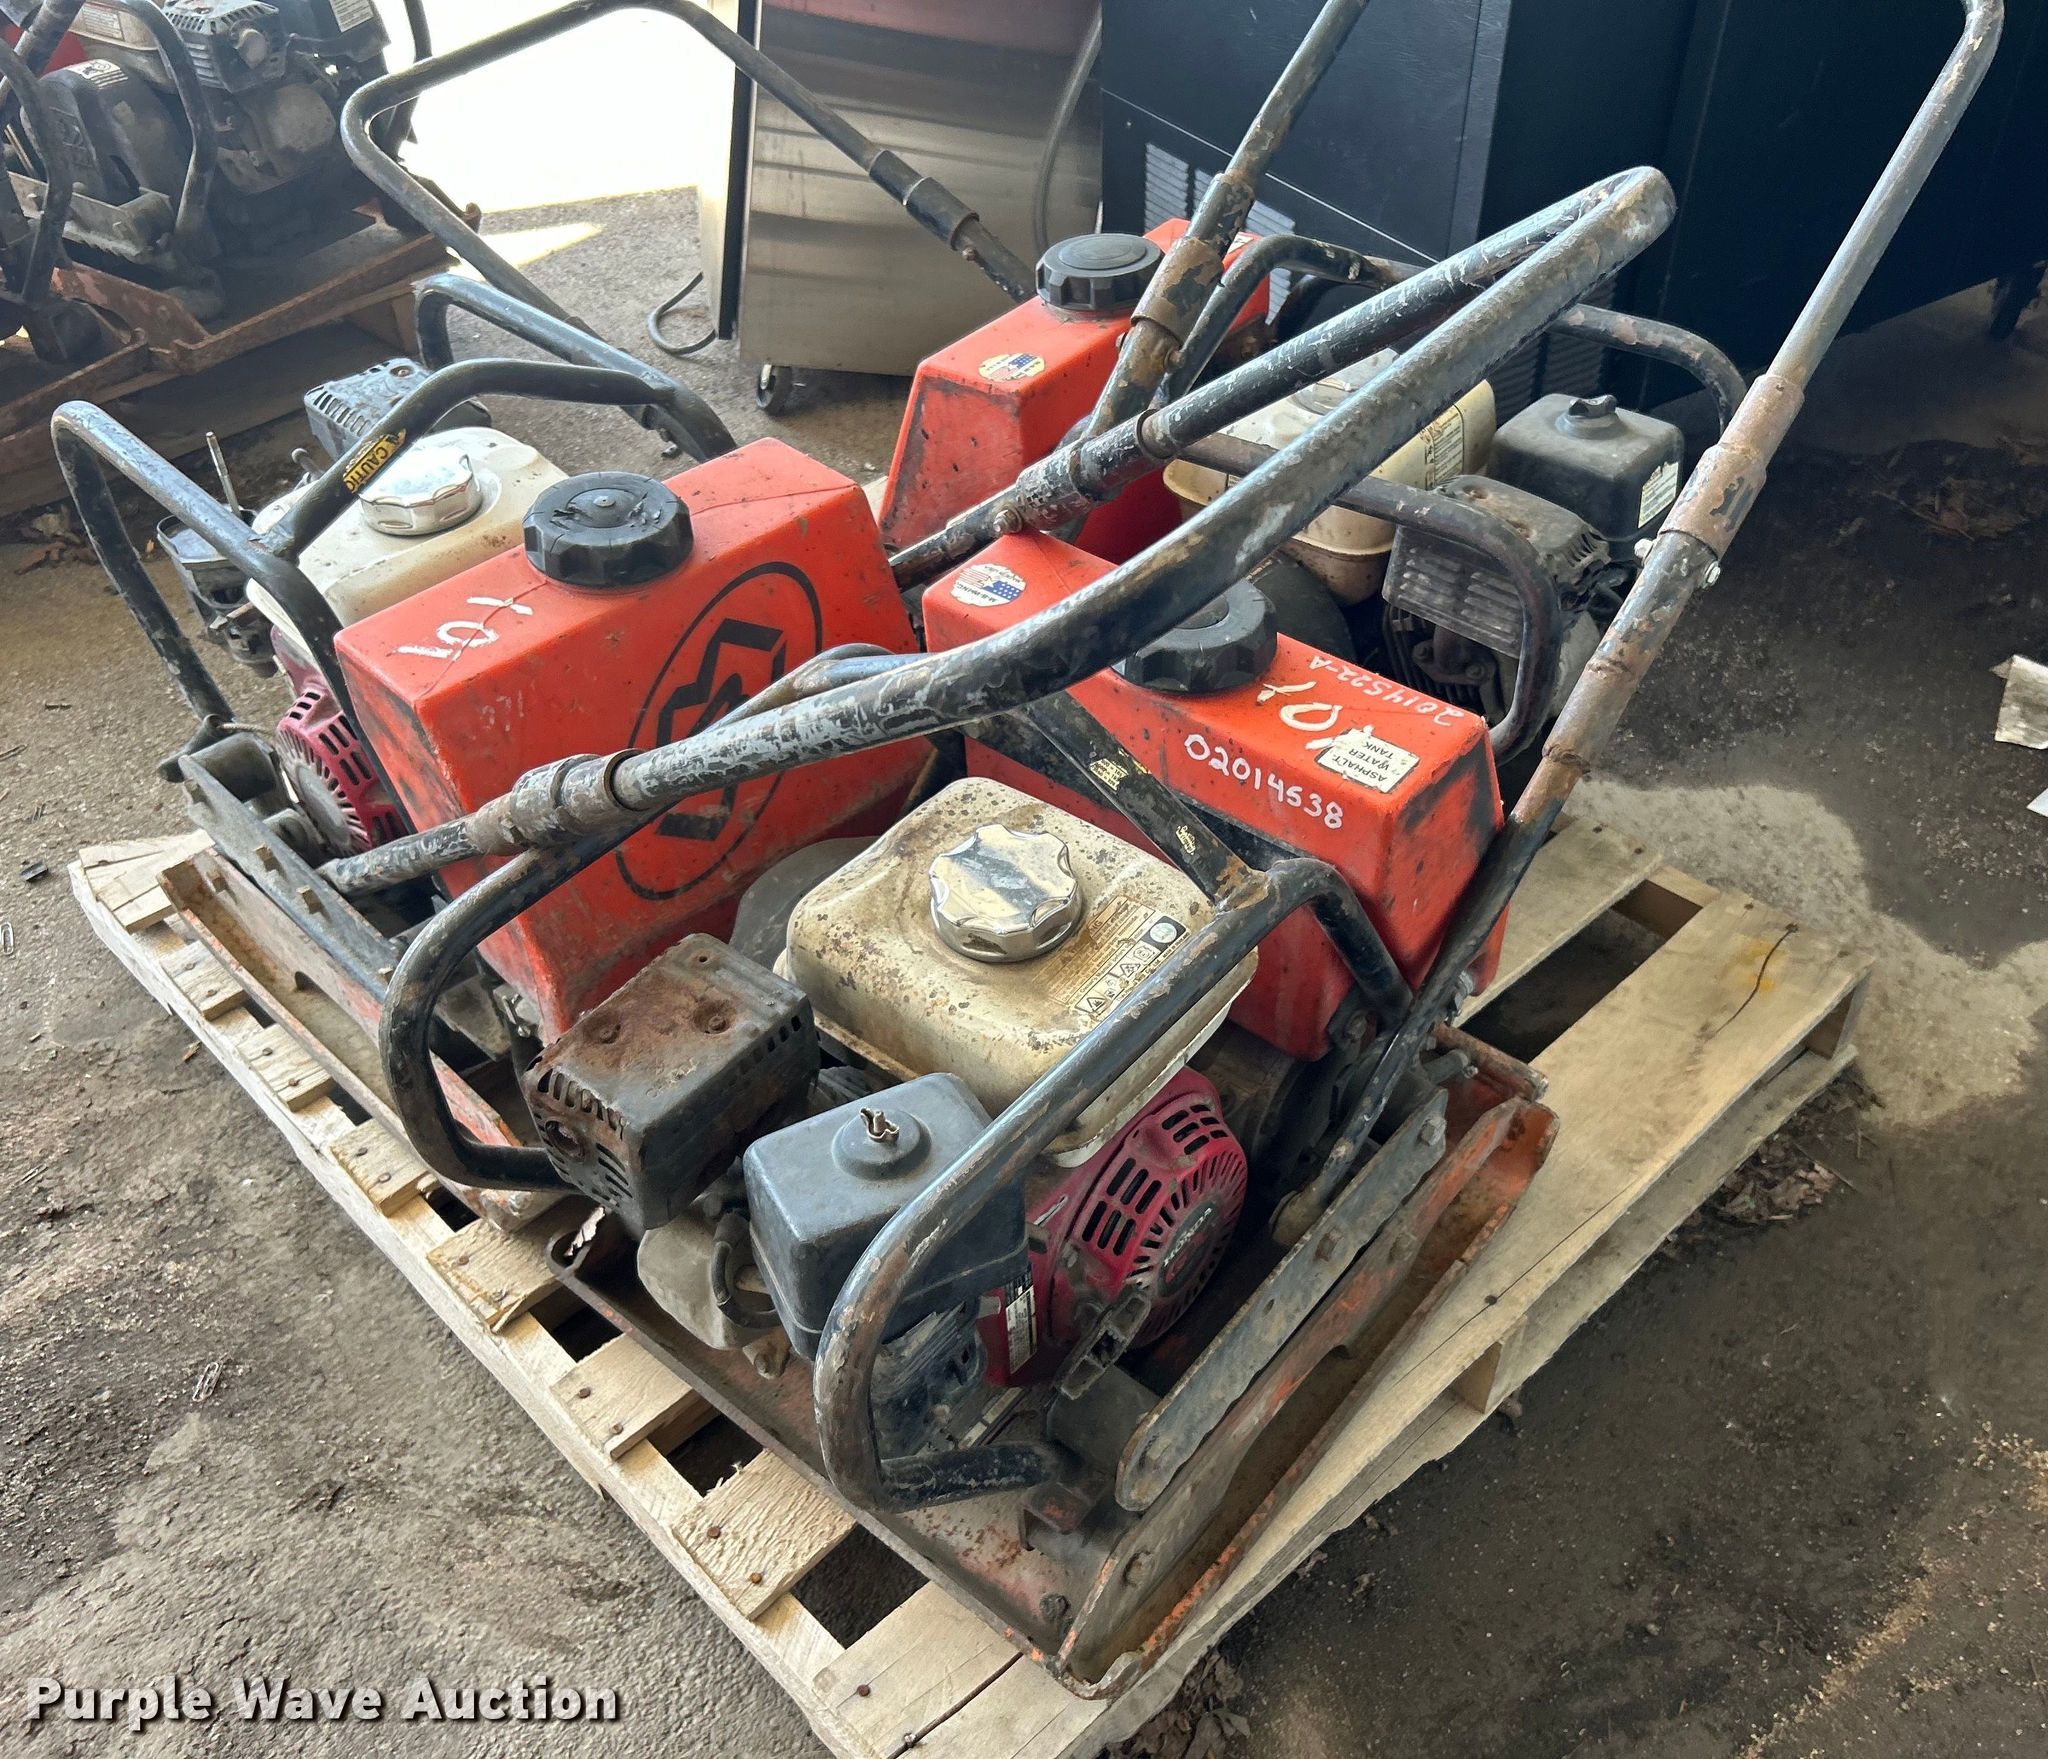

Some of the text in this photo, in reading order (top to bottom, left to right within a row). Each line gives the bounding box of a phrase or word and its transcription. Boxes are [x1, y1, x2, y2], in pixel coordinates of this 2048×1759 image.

[1349, 749, 1390, 770] WATER
[1363, 741, 1394, 760] TANK
[1184, 734, 1344, 830] 02014538
[1164, 1207, 1213, 1267] HONDA
